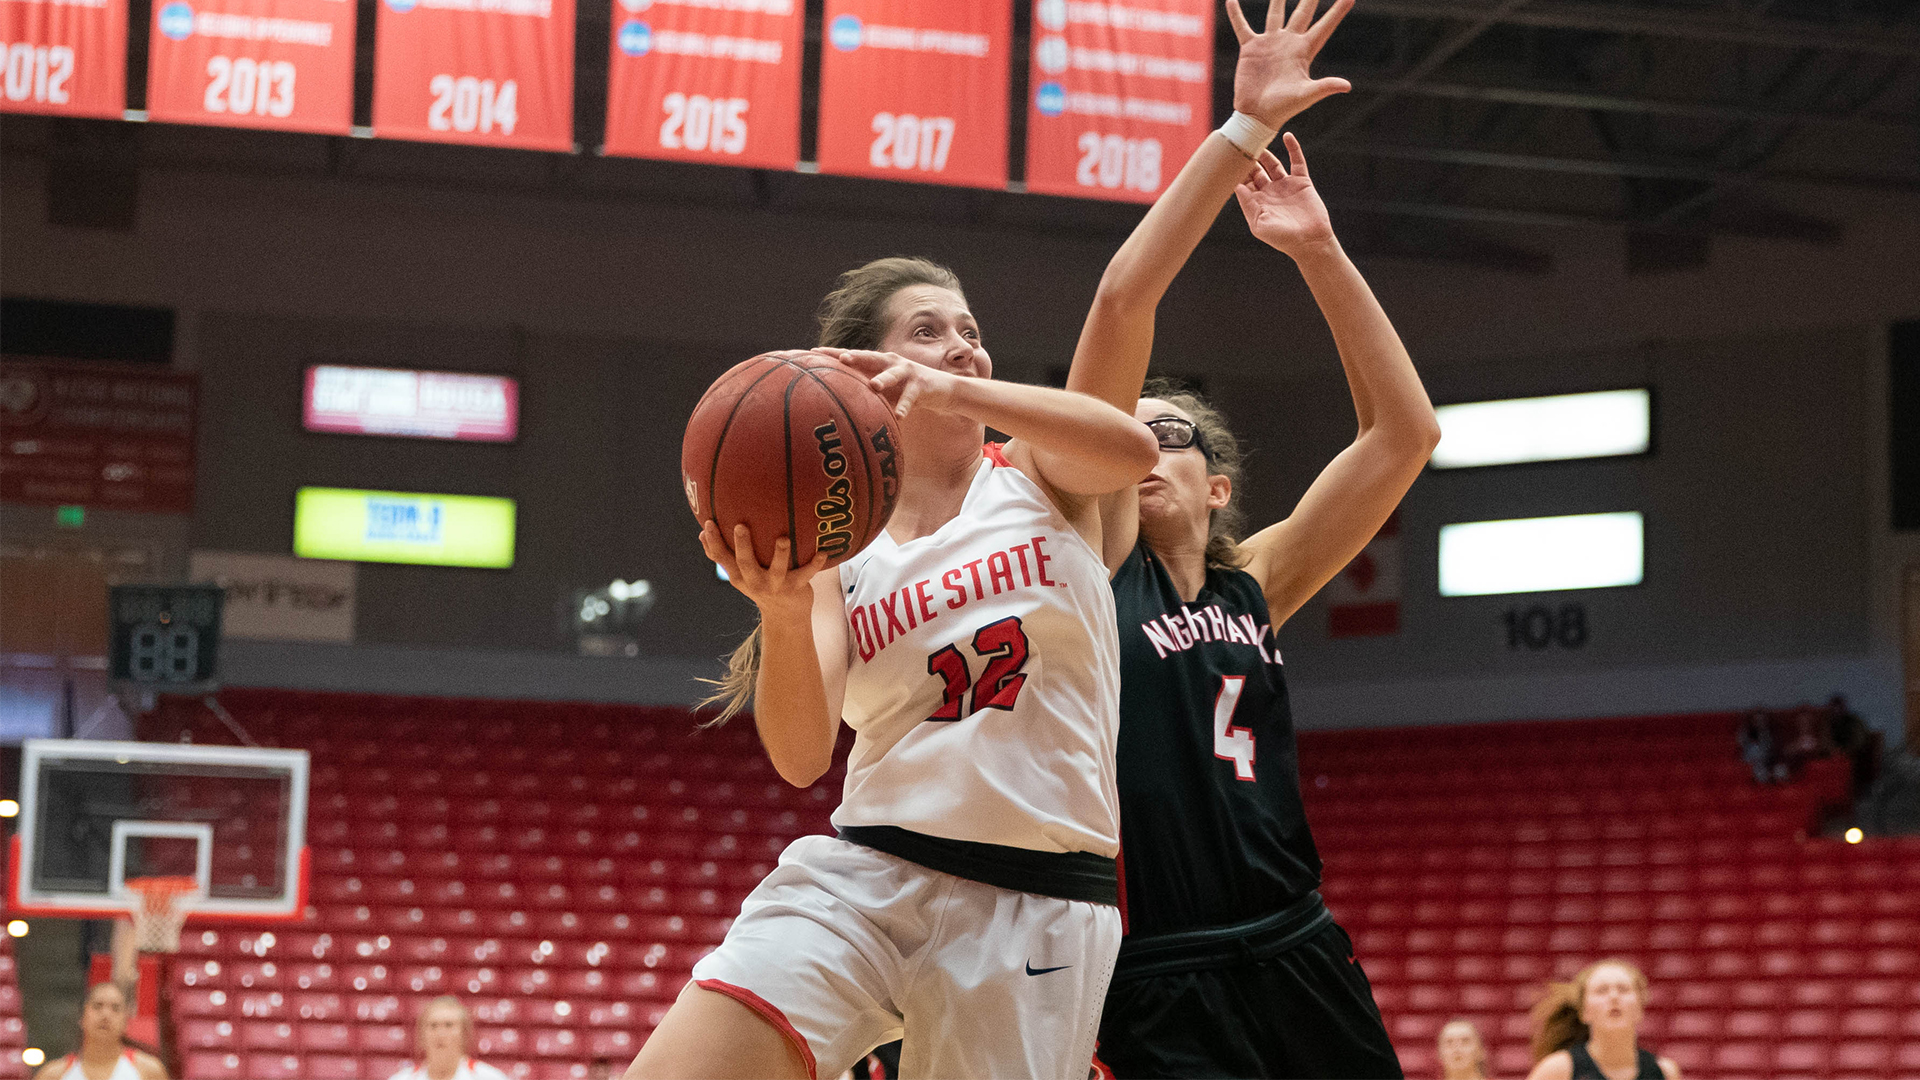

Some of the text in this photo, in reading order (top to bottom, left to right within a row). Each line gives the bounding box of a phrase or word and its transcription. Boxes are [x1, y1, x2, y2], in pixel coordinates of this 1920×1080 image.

[204, 56, 297, 118] 2013
[428, 74, 517, 136] 2014
[659, 92, 750, 155] 2015
[869, 112, 956, 173] 2017
[1076, 131, 1163, 193] 2018
[814, 419, 854, 560] Wilson
[850, 579, 938, 664] DIXIE
[941, 536, 1055, 610] STATE
[1503, 604, 1588, 649] 108
[924, 615, 1029, 722] 12
[1214, 675, 1257, 783] 4
